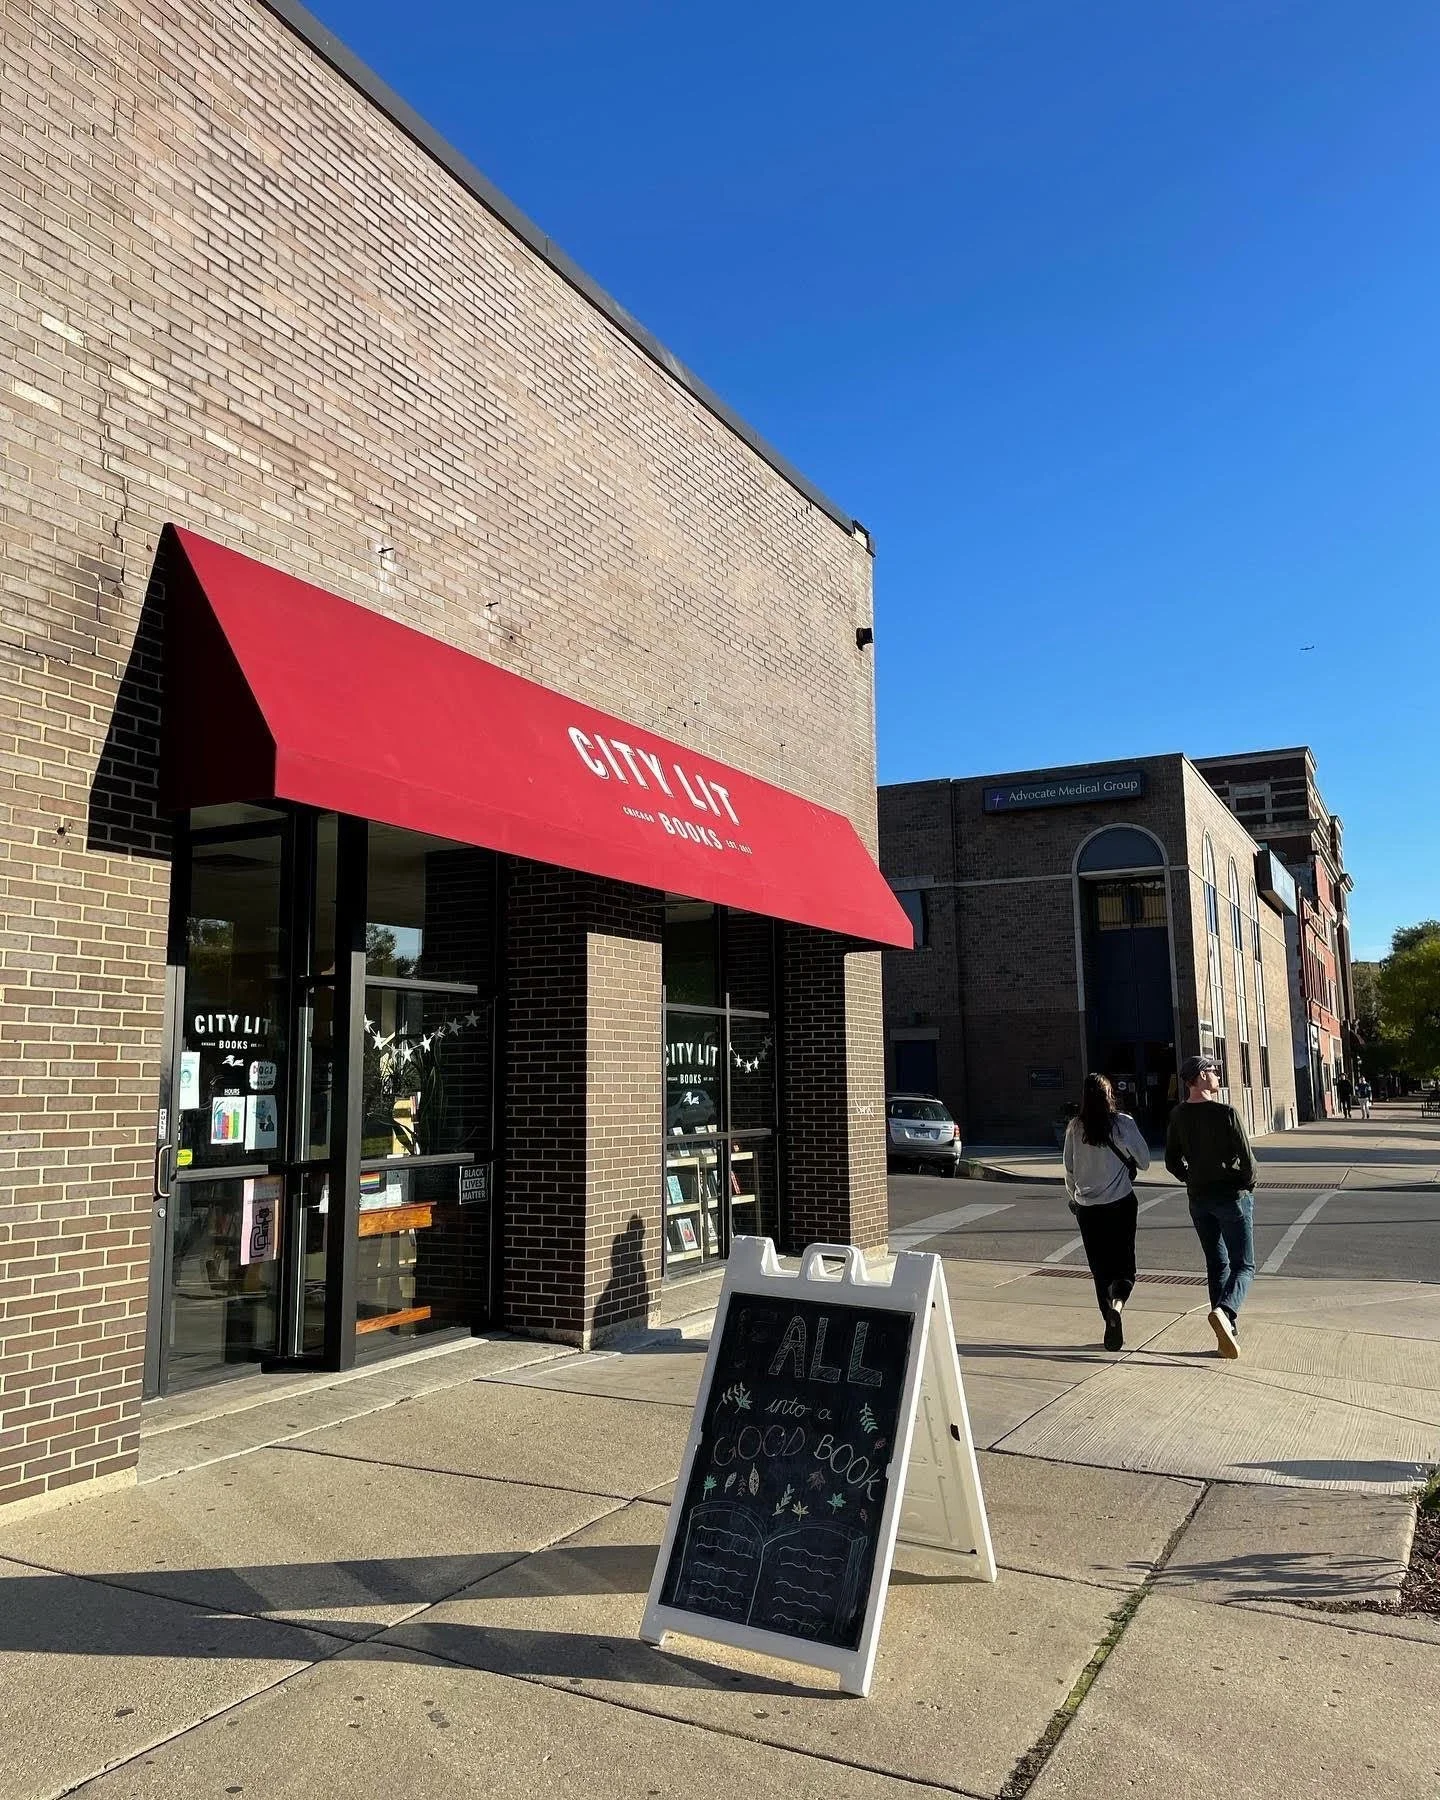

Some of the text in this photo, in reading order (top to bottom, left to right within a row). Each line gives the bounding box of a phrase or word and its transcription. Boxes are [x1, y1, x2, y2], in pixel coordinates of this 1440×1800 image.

[567, 726, 740, 826] CITY LIT
[1008, 780, 1138, 802] Advocate Medical Group
[658, 812, 723, 850] BOOKS
[194, 1014, 272, 1036] CITY LIT
[218, 1040, 248, 1050] BOOKS
[698, 1043, 718, 1067] LIT
[680, 1074, 701, 1084] BOOKS
[464, 1167, 484, 1178] BLACK
[462, 1189, 486, 1200] MATTER
[464, 1179, 484, 1189] LIVES
[765, 1397, 833, 1420] into a
[713, 1425, 880, 1502] GOOD BOOK
